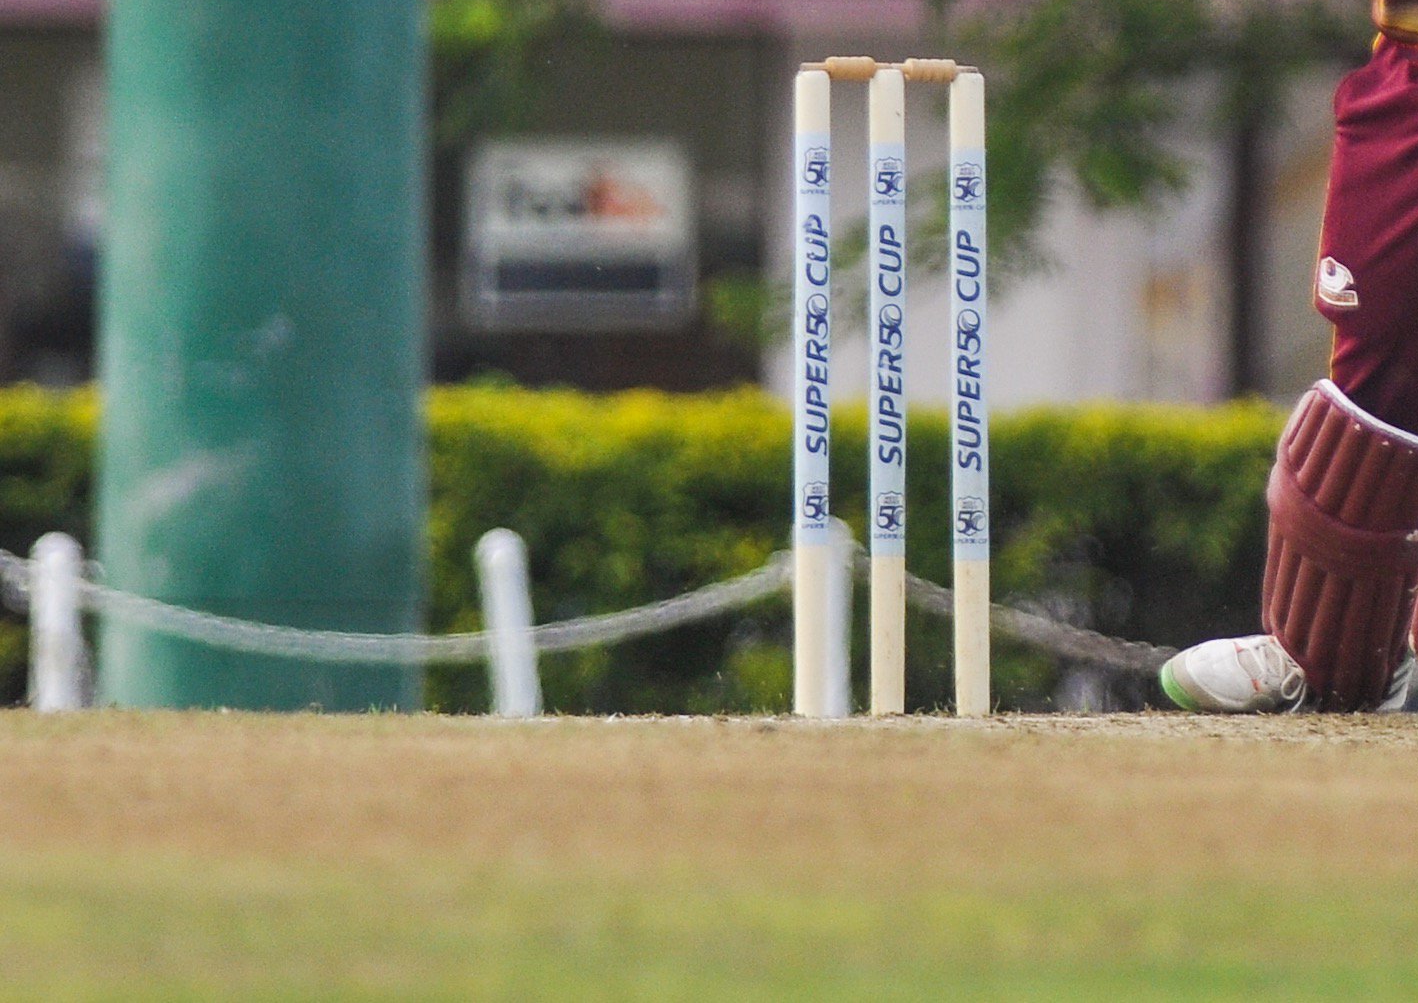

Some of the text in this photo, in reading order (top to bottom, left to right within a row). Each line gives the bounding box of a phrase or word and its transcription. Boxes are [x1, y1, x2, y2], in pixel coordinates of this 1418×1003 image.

[804, 214, 829, 286] CUP
[878, 224, 902, 297] CUP
[956, 229, 980, 302] CUP
